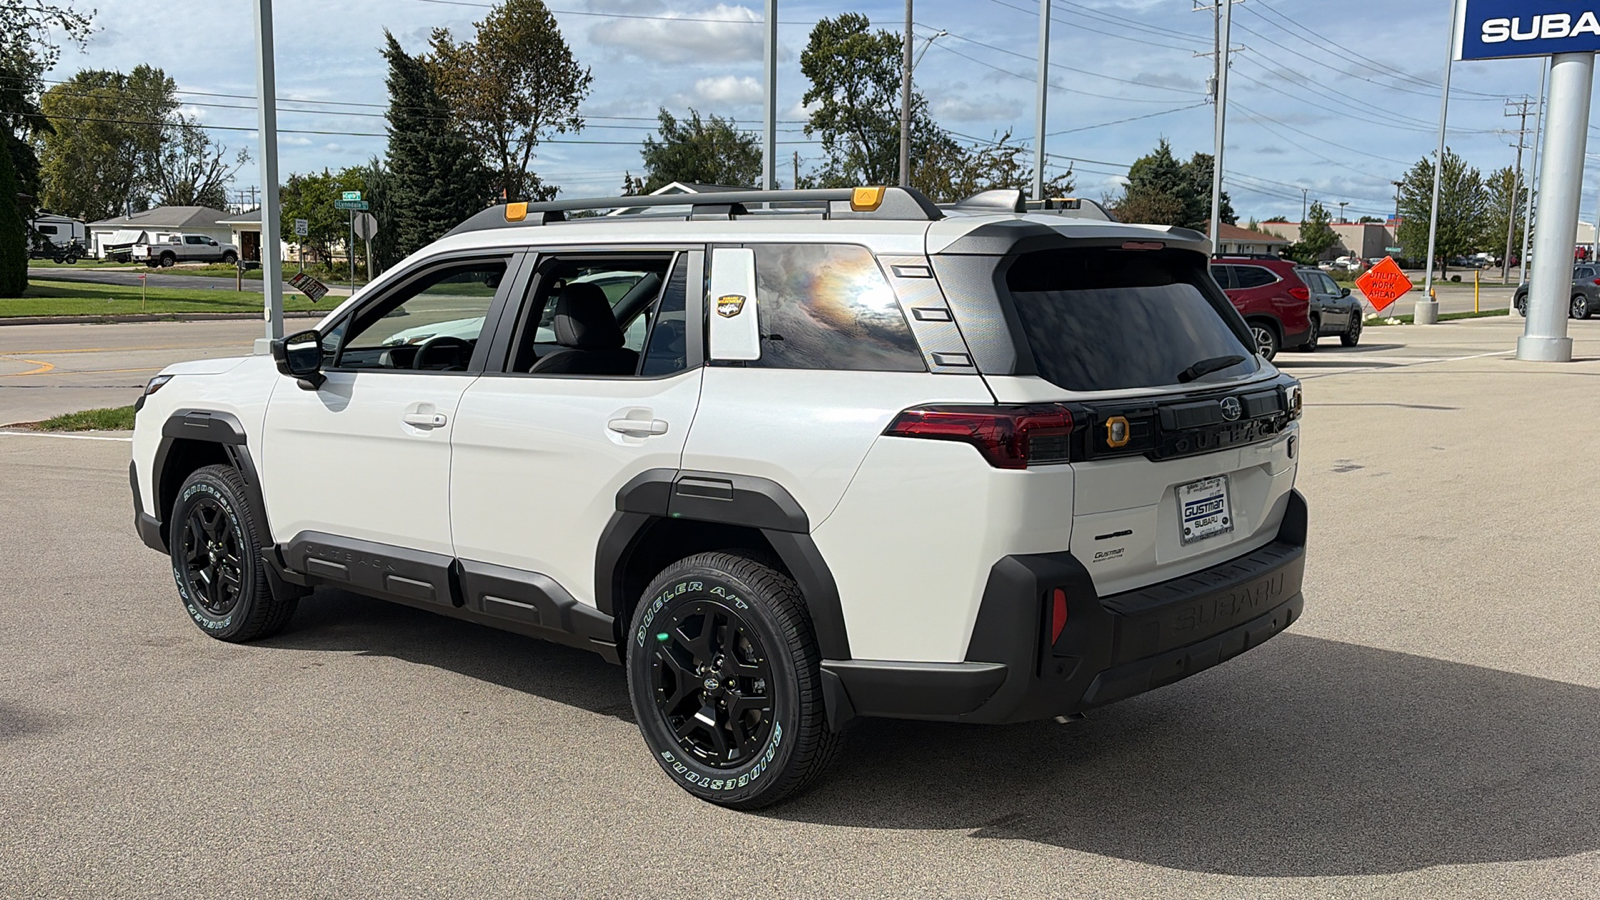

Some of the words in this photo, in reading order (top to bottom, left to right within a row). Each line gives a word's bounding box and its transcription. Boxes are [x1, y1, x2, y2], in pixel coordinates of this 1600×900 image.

[1369, 272, 1399, 280] UTILITY
[1371, 281, 1394, 289] WORK
[1369, 290, 1396, 298] AHEAD
[1175, 418, 1281, 452] OUTBACK
[1194, 515, 1218, 528] SUBARU
[305, 545, 396, 572] OUTBACK
[636, 581, 704, 648] DUELER
[710, 586, 749, 610] A/T
[1174, 572, 1284, 631] SUBARU
[187, 603, 232, 629] DUELER
[661, 721, 783, 791] BRIDGESTONE
